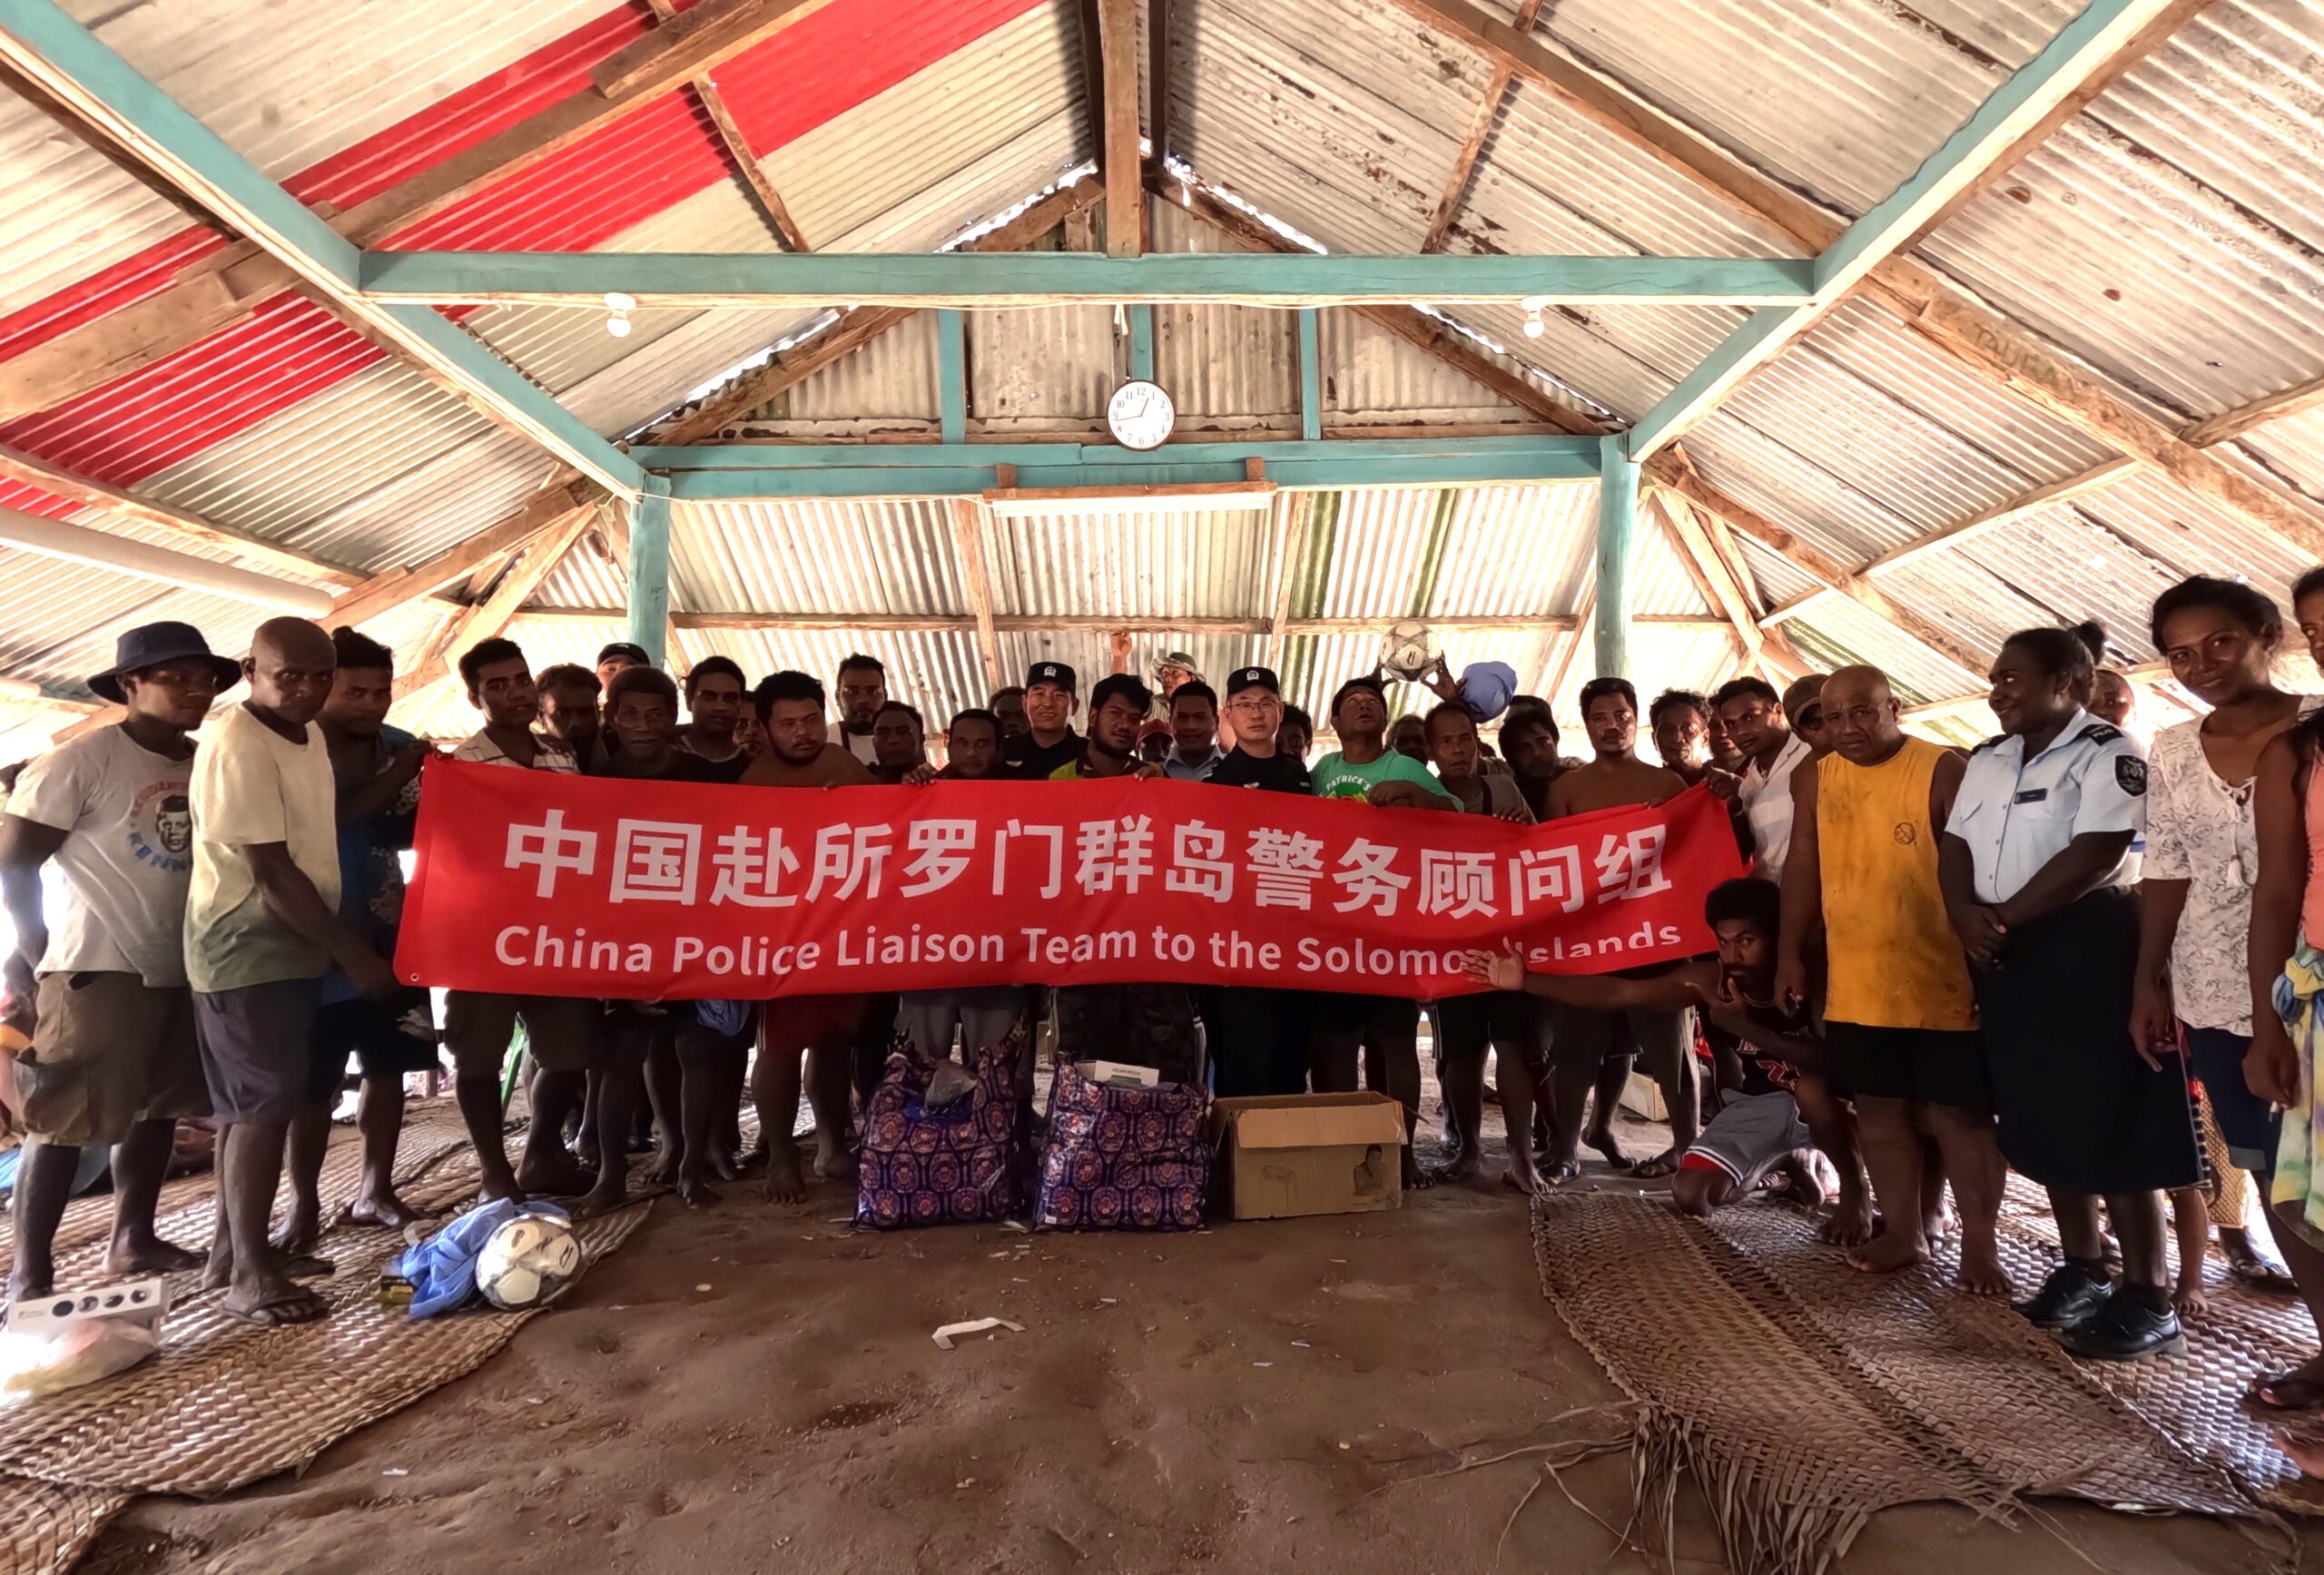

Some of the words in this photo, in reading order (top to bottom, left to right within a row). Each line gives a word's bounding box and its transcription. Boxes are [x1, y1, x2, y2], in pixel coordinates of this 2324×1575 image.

[1126, 391, 1133, 399] 11
[1137, 387, 1146, 396] 12
[1117, 399, 1125, 409] 10
[1325, 774, 1372, 792] PATRICK'S
[504, 809, 1672, 920] 中国赴所罗门群岛警务顾问组
[496, 925, 652, 972] China
[673, 935, 821, 976] Police
[837, 923, 1004, 966] Liaison
[1021, 926, 1137, 964] Team
[1152, 926, 1196, 962] to
[1208, 930, 1281, 970] the
[1297, 936, 1471, 976] Solomo
